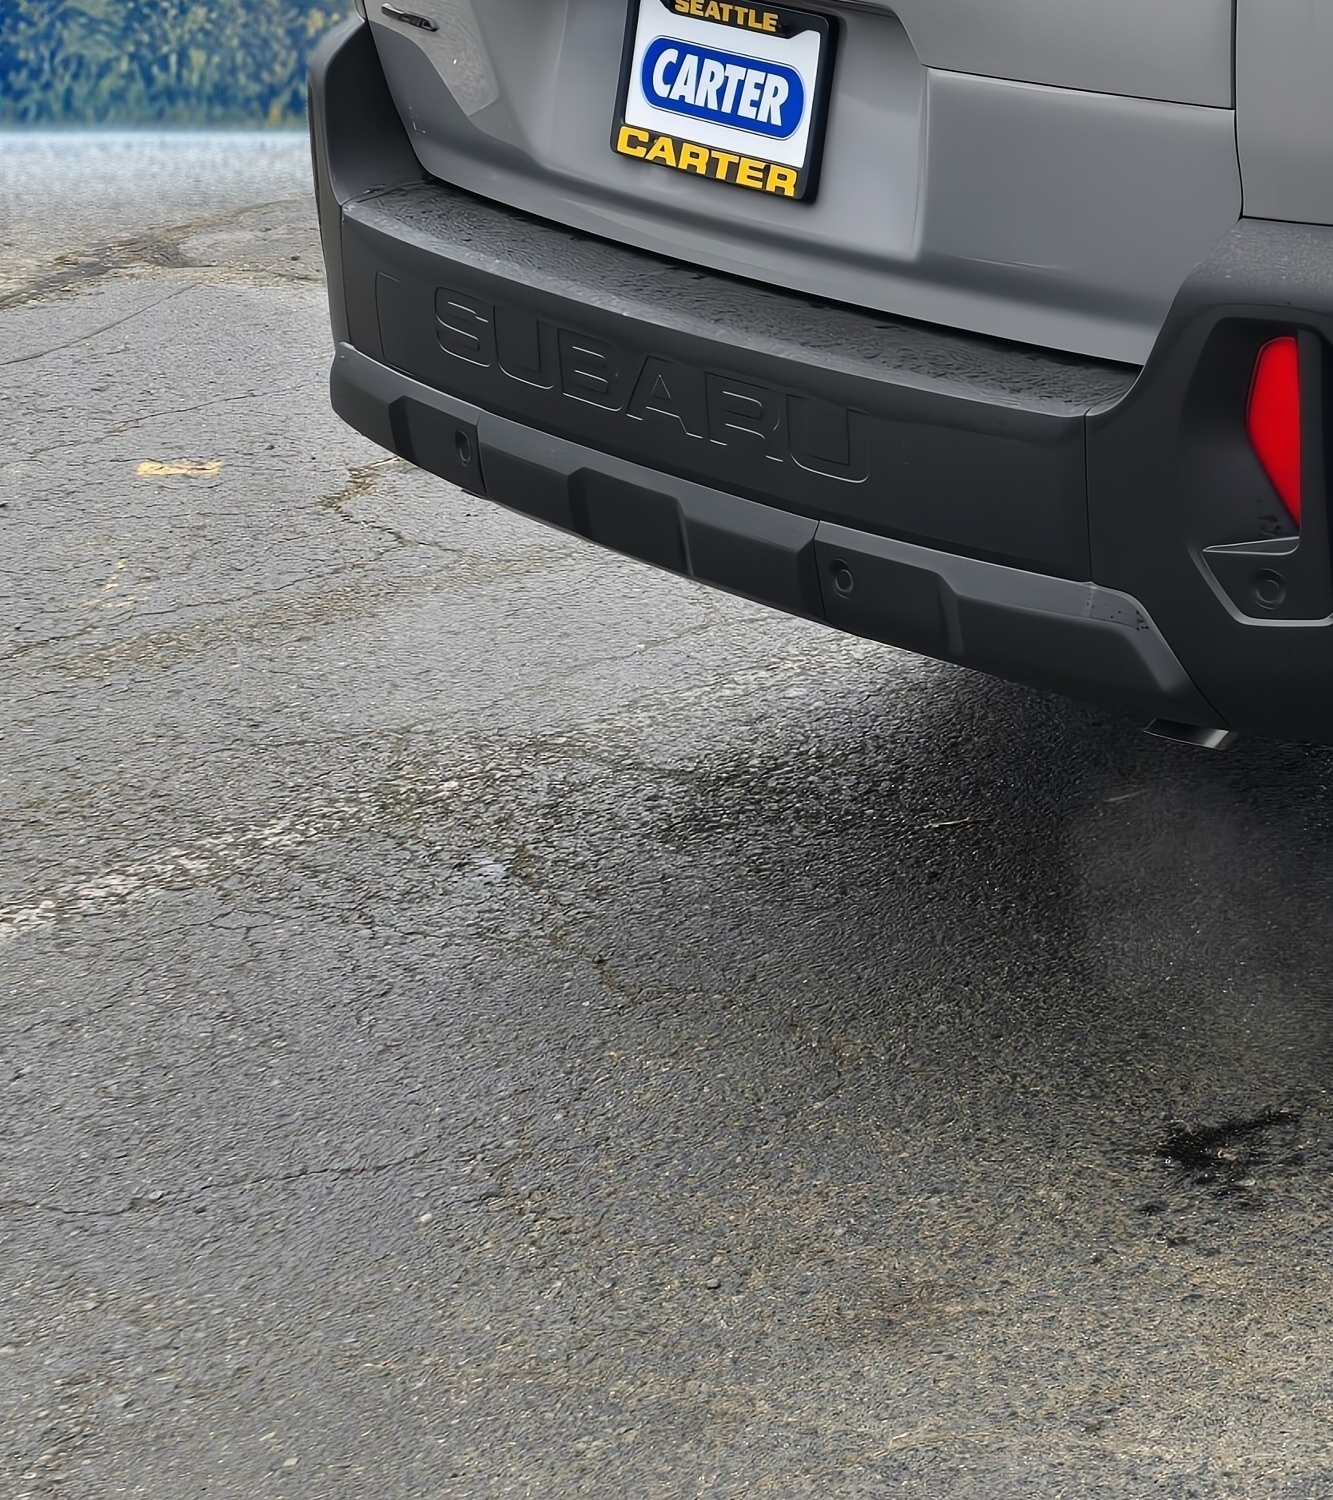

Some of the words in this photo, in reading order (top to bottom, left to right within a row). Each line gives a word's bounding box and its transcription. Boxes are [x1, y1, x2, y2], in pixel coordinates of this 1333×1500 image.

[652, 48, 789, 126] CARTER
[617, 125, 798, 197] CARTER
[433, 285, 870, 484] SUBARU
